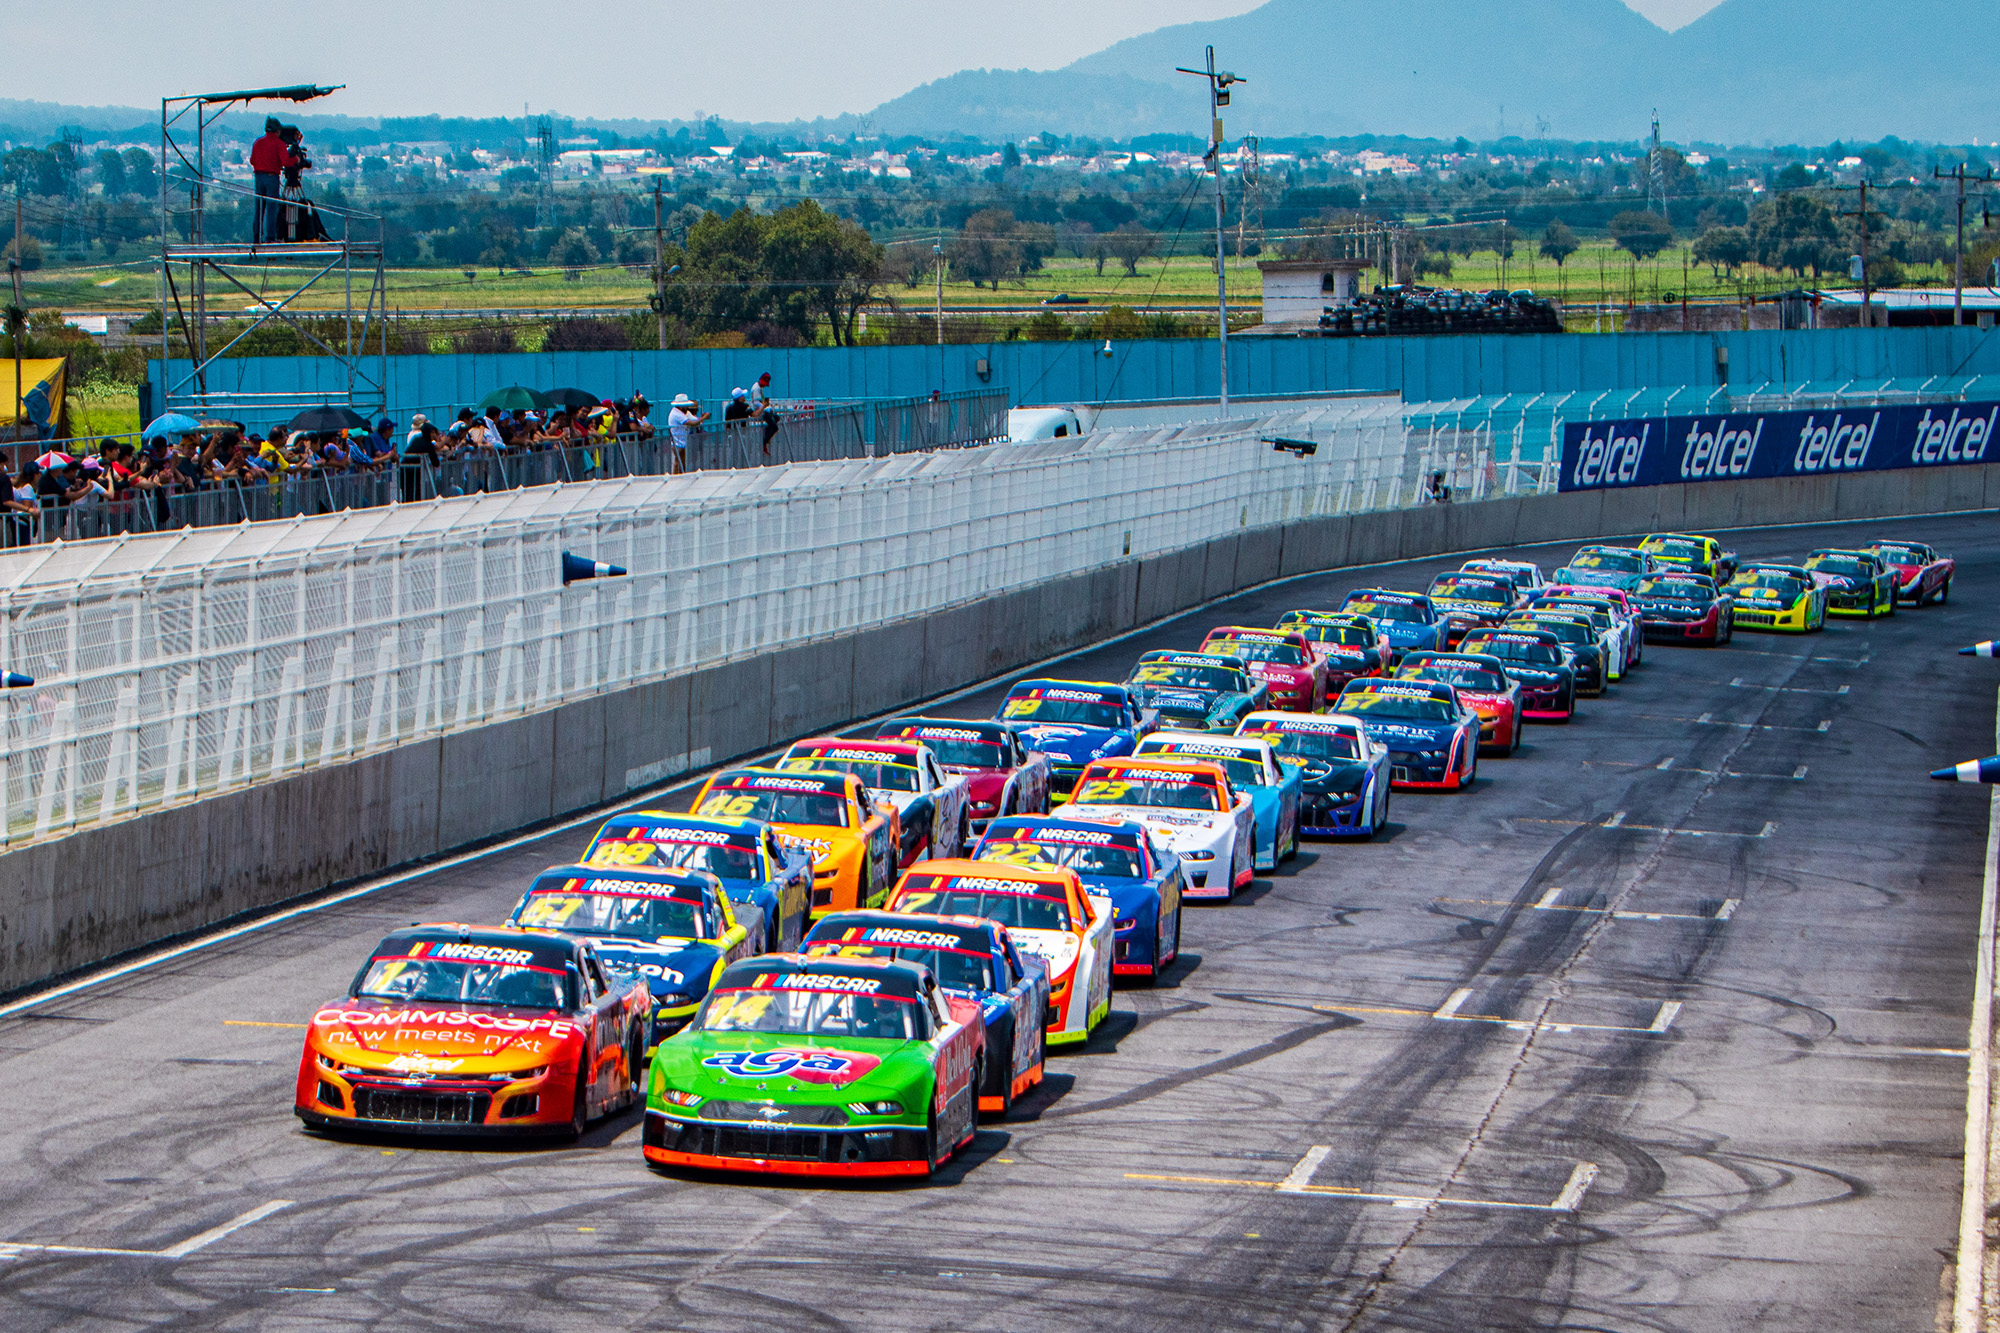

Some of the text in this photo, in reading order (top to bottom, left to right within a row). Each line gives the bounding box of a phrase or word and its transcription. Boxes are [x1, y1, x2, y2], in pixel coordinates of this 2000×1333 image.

[1793, 411, 1880, 471] telcel
[1911, 405, 1998, 463] telcel
[1573, 423, 1650, 486] telcel
[1680, 418, 1764, 477] telcel
[1373, 595, 1414, 605] NASCAR
[1240, 633, 1286, 643] NASCAR
[1496, 633, 1540, 643] NASCAR
[1173, 656, 1223, 666] NASCAR
[1434, 658, 1482, 669] NASCAR
[1132, 667, 1176, 683] 52
[1046, 688, 1103, 702] NASCAR
[1380, 686, 1432, 697] NASCAR
[1002, 699, 1042, 717] 19
[1338, 696, 1380, 711] 57
[920, 727, 982, 740] NASCAR
[1280, 721, 1340, 734] NASCAR
[831, 748, 897, 763] NASCAR
[1179, 744, 1242, 758] NASCAR
[754, 777, 825, 792] NASCAR
[1128, 768, 1195, 783] NASCAR
[1077, 781, 1131, 801] 23
[697, 794, 759, 816] 46
[651, 827, 730, 845] NASCAR
[1037, 828, 1112, 844] NASCAR
[981, 843, 1041, 863] 22
[589, 879, 676, 897] NASCAR
[955, 877, 1041, 895] NASCAR
[901, 892, 937, 913] 7
[869, 928, 961, 948] NASCAR
[437, 943, 534, 965] NASCAR
[372, 961, 407, 991] 1
[782, 973, 882, 993] NASCAR
[706, 995, 774, 1026] 14
[313, 1008, 570, 1039] COMMSCOPE
[328, 1028, 542, 1053] now meets next
[385, 1055, 465, 1072] telcel
[701, 1050, 852, 1079] aga
